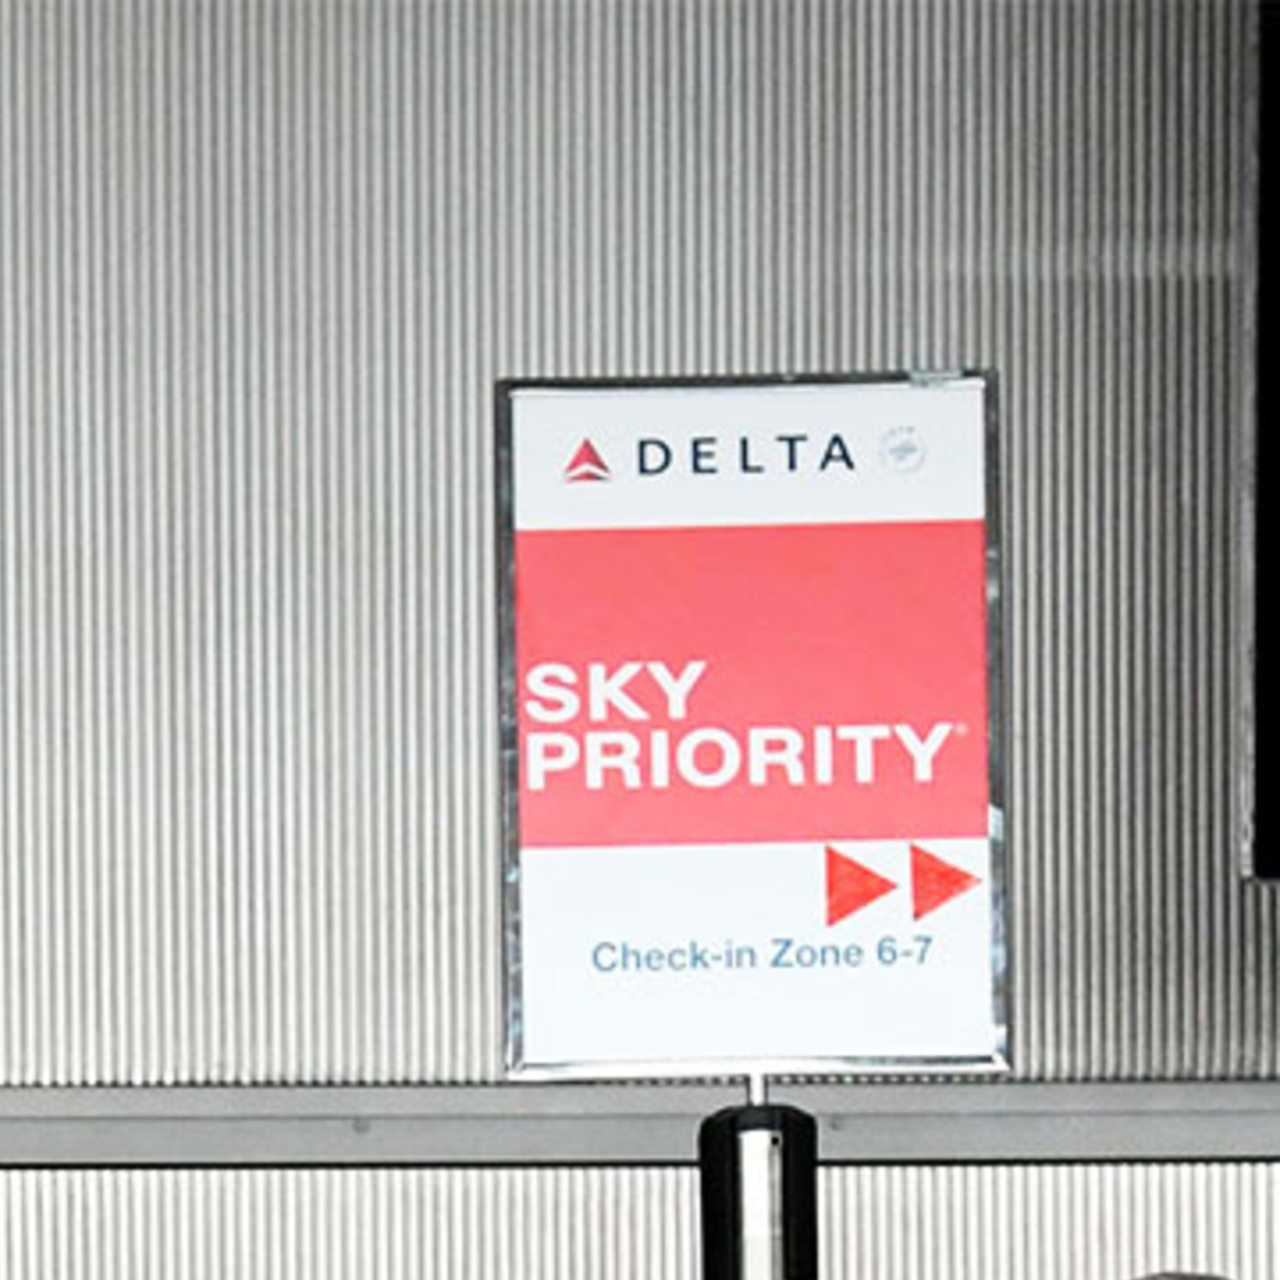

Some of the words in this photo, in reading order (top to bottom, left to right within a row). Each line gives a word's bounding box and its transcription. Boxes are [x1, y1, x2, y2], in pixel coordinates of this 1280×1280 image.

[638, 434, 855, 475] DELTA
[524, 660, 706, 722] SKY
[525, 723, 954, 790] PRIORITY
[592, 939, 757, 972] Check-in
[770, 938, 864, 968] Zone
[876, 935, 933, 965] 6-7
